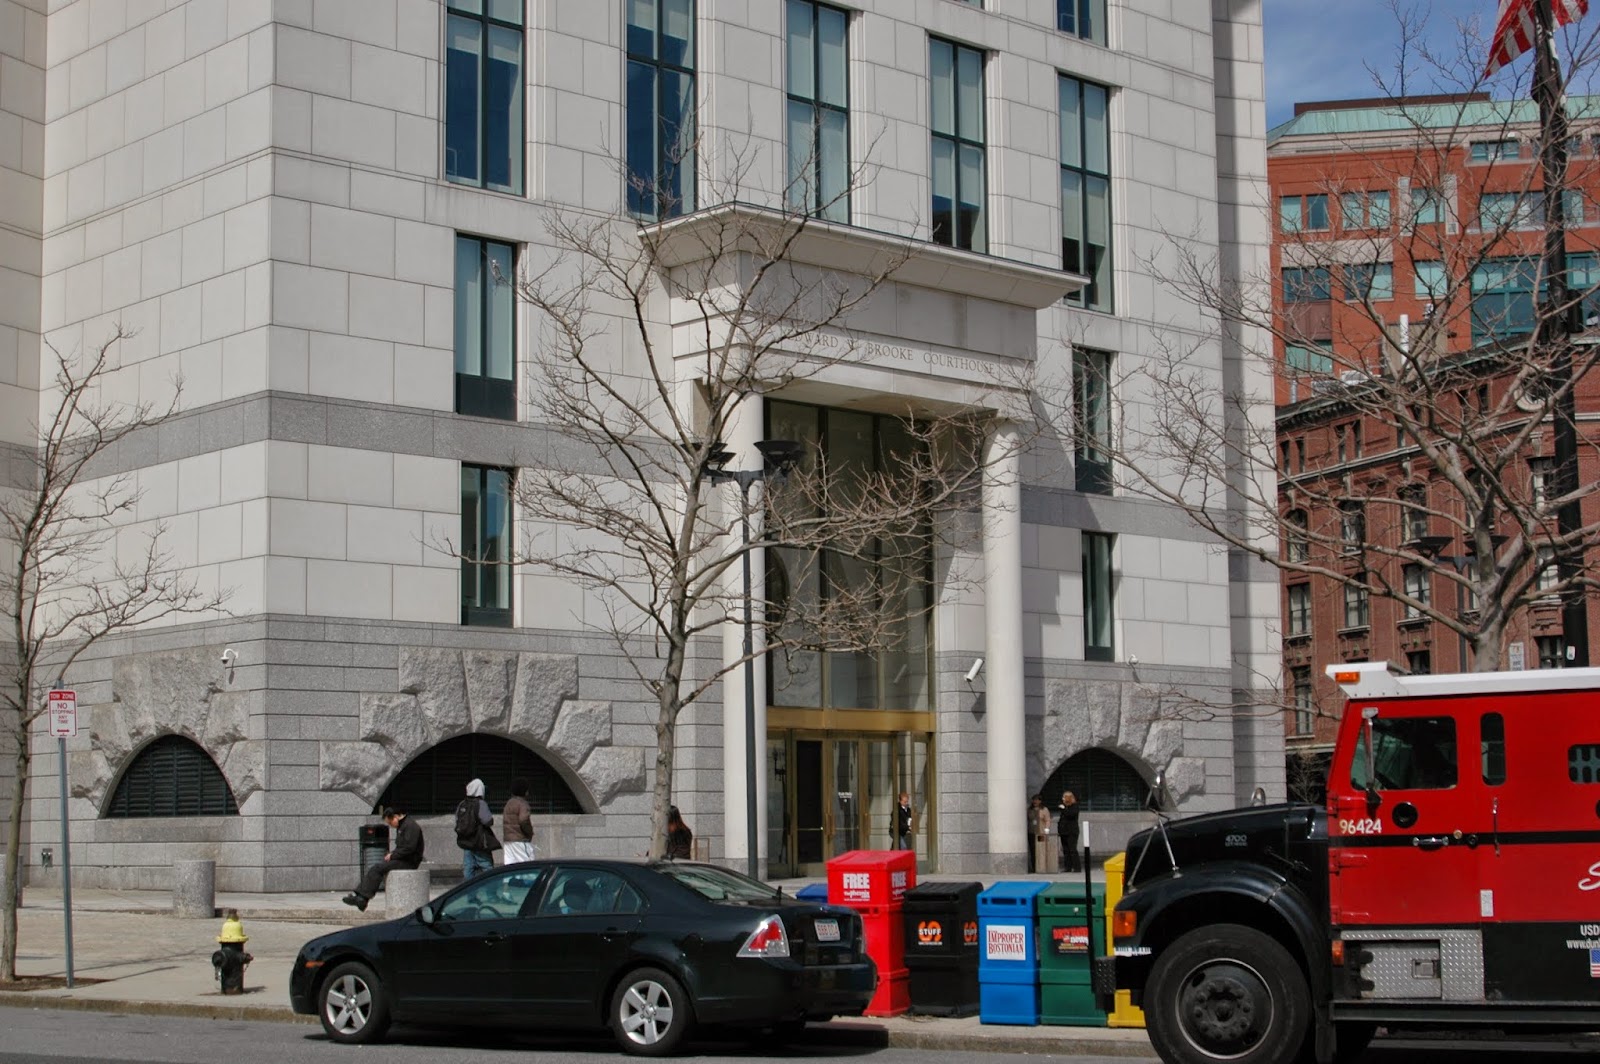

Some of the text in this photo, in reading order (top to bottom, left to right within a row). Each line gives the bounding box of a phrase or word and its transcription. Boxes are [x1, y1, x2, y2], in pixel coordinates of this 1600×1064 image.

[866, 342, 914, 361] BROOKE
[923, 352, 995, 375] COURTHOUSE
[1339, 818, 1382, 834] 96424
[843, 873, 870, 889] FREE
[891, 871, 907, 888] FREE
[918, 928, 942, 936] STUFF
[988, 930, 1024, 943] IMPROPER
[1580, 924, 1600, 936] USD
[988, 943, 1024, 955] BOSTONIAN
[1565, 938, 1600, 949] www.dun
